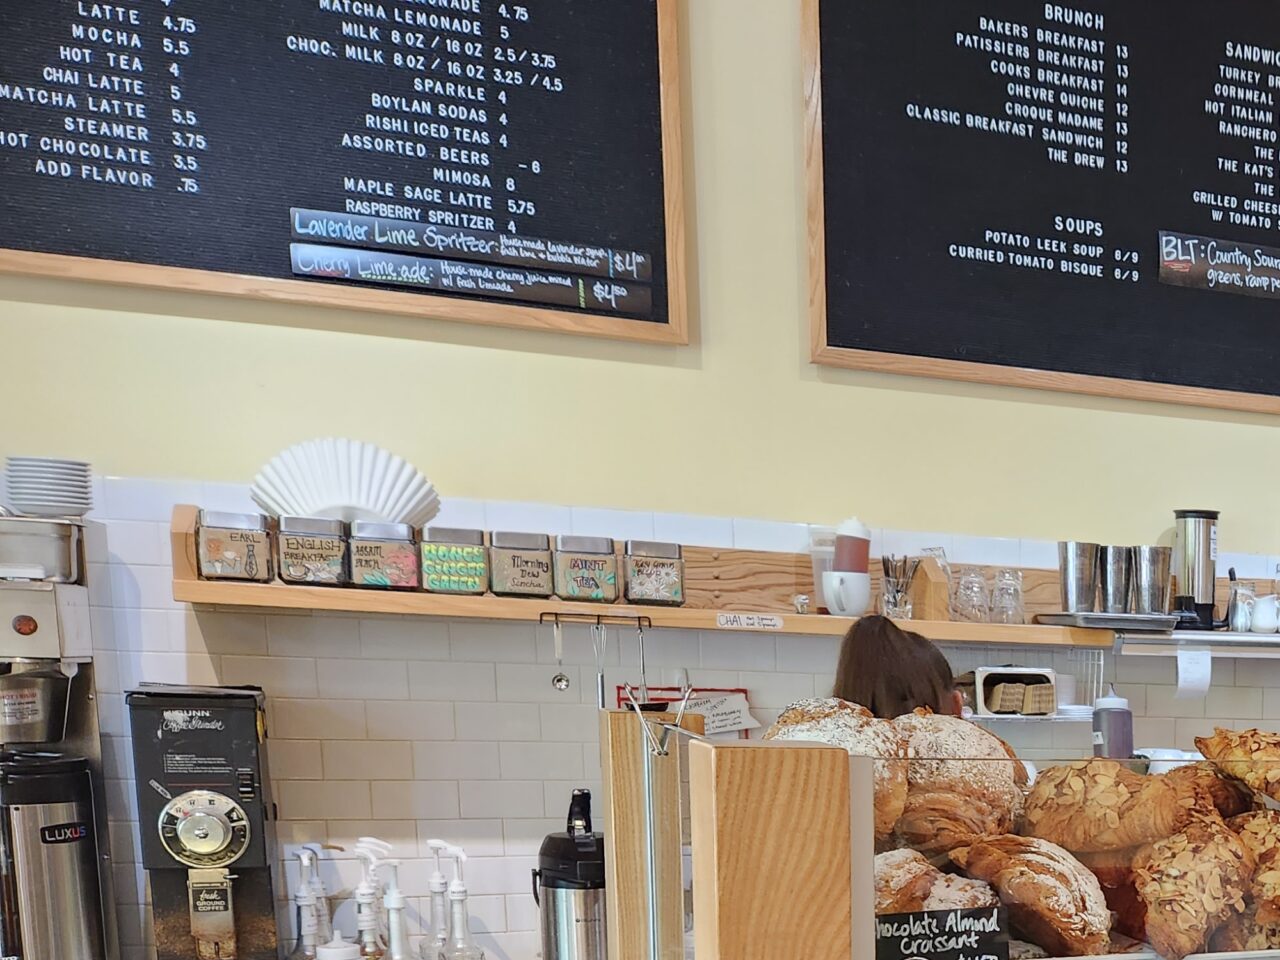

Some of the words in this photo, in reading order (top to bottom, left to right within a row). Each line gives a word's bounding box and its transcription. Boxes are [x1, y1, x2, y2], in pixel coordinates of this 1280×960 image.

[77, 0, 140, 25] LATTE
[162, 15, 196, 34] 4.75
[1044, 3, 1104, 31] BRUNCH
[71, 23, 142, 49] MOCHA
[162, 37, 190, 56] 5.5
[979, 16, 1029, 39] BAKERS
[1036, 28, 1105, 55] BREAKFAST
[1116, 44, 1129, 60] 13
[59, 45, 92, 64] HOT
[106, 52, 143, 72] TEA
[956, 32, 1030, 60] PATISSIERS
[1037, 47, 1105, 74] BREAKFAST
[1116, 63, 1129, 79] 13
[42, 66, 80, 85] CHAI
[87, 72, 145, 96] LATTE
[413, 77, 486, 101] SPARKLE
[0, 83, 77, 109] MATCHA
[87, 96, 147, 119] LATTE
[171, 108, 197, 126] 5.5
[371, 92, 432, 115] BOYLAN
[438, 103, 488, 123] SODAS
[1006, 82, 1055, 104] CHEVRE
[1059, 91, 1105, 113] QUICHE
[1204, 99, 1226, 116] HOT
[1231, 104, 1273, 125] ITALIAN
[365, 113, 409, 133] RISHI
[413, 120, 449, 139] ICED
[453, 126, 491, 145] TEAS
[1004, 101, 1054, 123] CROQUE
[1057, 110, 1104, 132] MADAME
[64, 116, 149, 142] STEAMER
[171, 131, 207, 150] 3.75
[39, 136, 151, 165] CHOCOLATE
[341, 132, 427, 158] ASSORTED
[439, 146, 490, 167] BEERS
[35, 158, 72, 177] ADD
[81, 164, 153, 188] FLAVOR
[433, 167, 492, 188] MIMOSA
[1217, 157, 1239, 173] THE
[1244, 162, 1274, 179] KAT'S
[343, 176, 394, 197] MAPLE
[403, 185, 442, 203] SAGE
[449, 191, 493, 210] LATTE
[295, 212, 369, 241] Lavender
[374, 221, 419, 246] Lime
[345, 198, 421, 221] RASPBERRY
[428, 210, 495, 231] SPRITZER
[1054, 215, 1104, 237] SOUPS
[985, 229, 1030, 248] POTATO
[1036, 237, 1067, 254] LEEK
[1072, 243, 1104, 258] SOUP
[1207, 241, 1252, 271] Country
[298, 253, 350, 276] Cherry
[230, 532, 261, 544] EARL
[286, 537, 342, 552] ENGLISH
[511, 555, 549, 572] Morning
[520, 569, 539, 579] Dew
[569, 558, 607, 571] MINT
[573, 576, 599, 589] TEA
[719, 615, 743, 627] CHAI
[45, 826, 87, 841] LUXUS
[875, 912, 939, 939] hocolate
[945, 908, 1000, 932] Almond
[900, 931, 979, 954] Croissant
